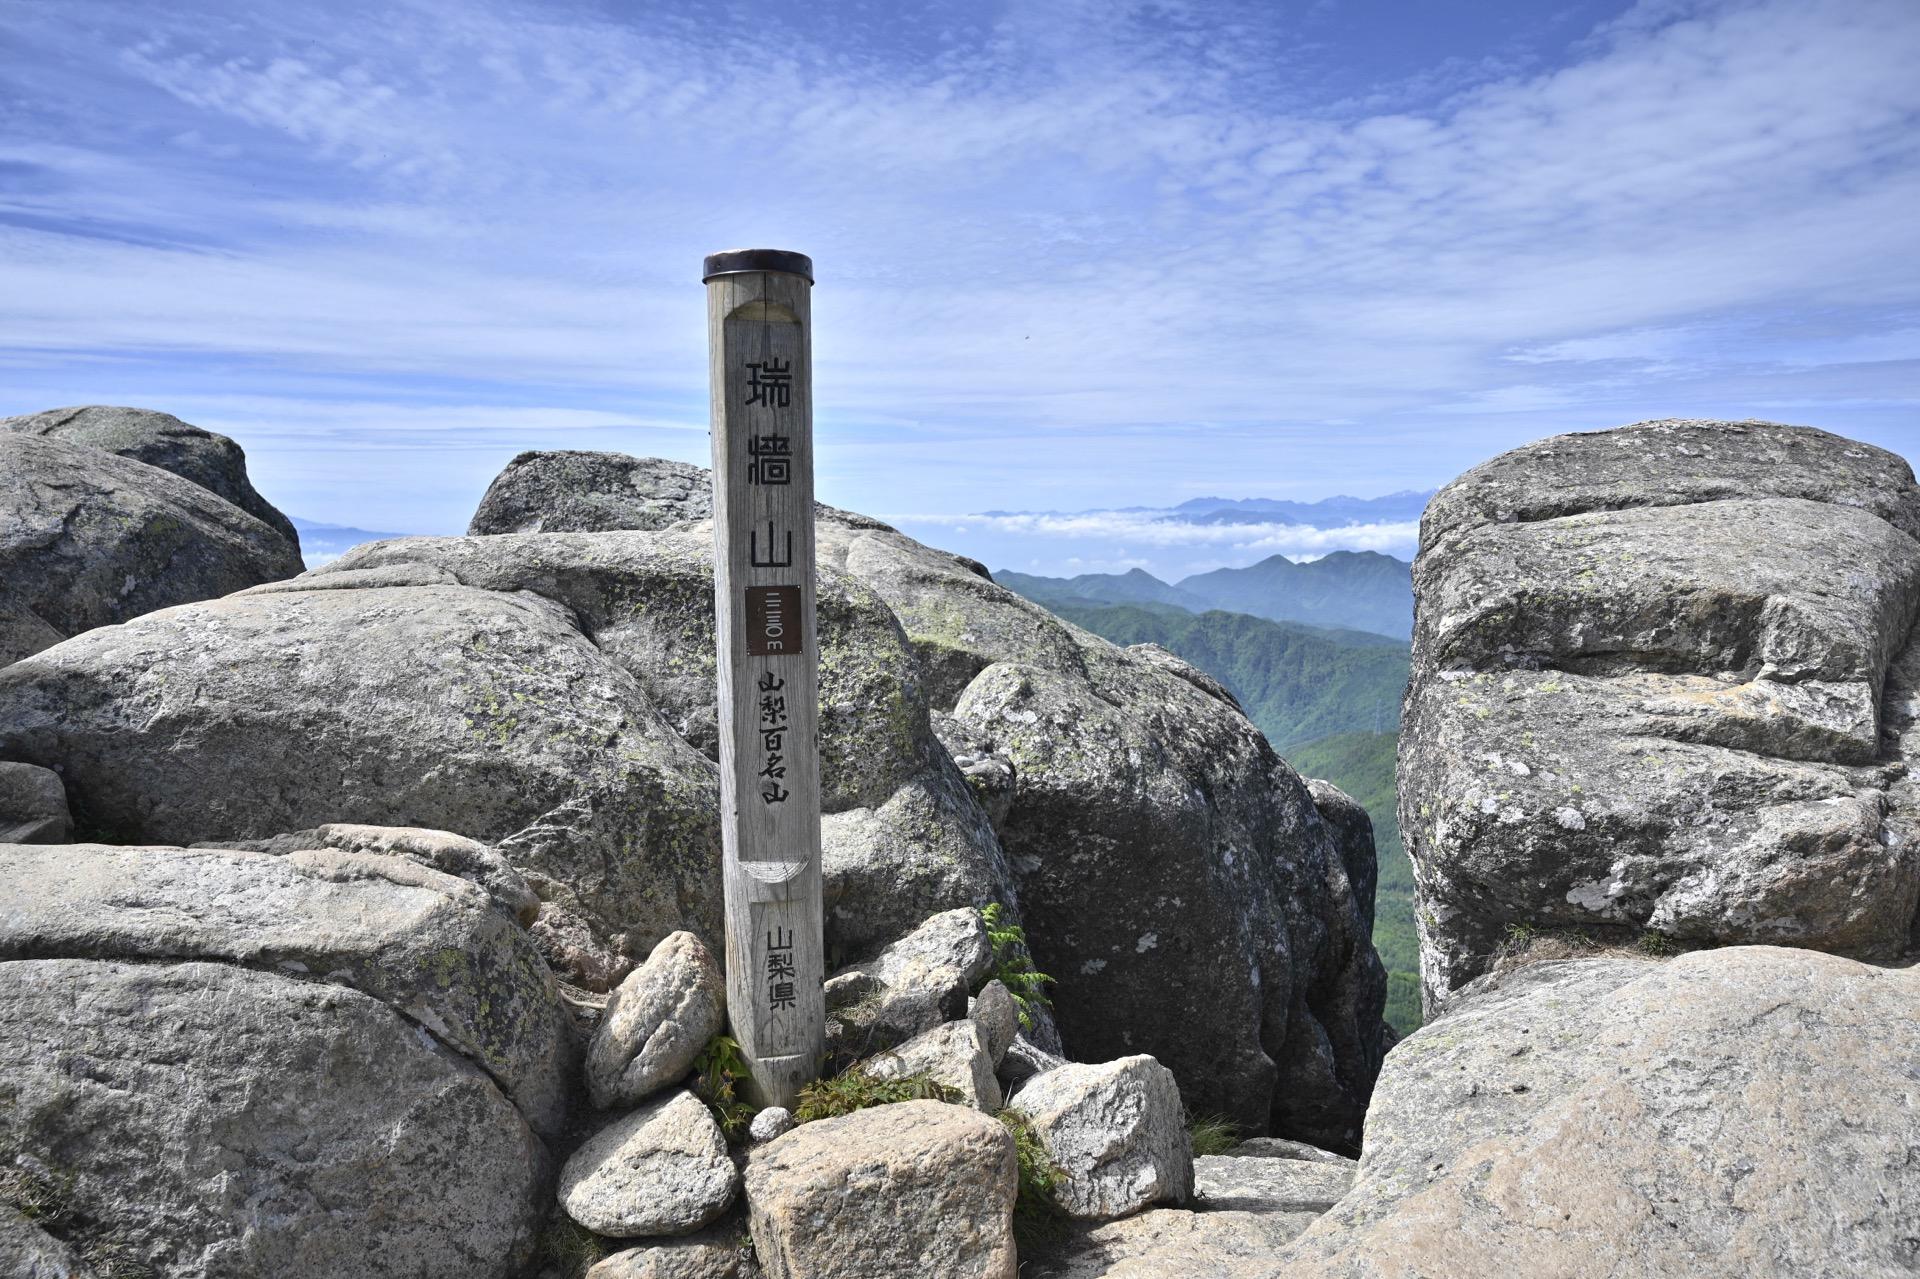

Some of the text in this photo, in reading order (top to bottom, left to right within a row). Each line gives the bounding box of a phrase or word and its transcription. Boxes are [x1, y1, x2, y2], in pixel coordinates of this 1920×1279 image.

[745, 357, 793, 568] 瑞牆山
[758, 671, 789, 804] 山梨百名山
[767, 926, 796, 1011] 山梨県
